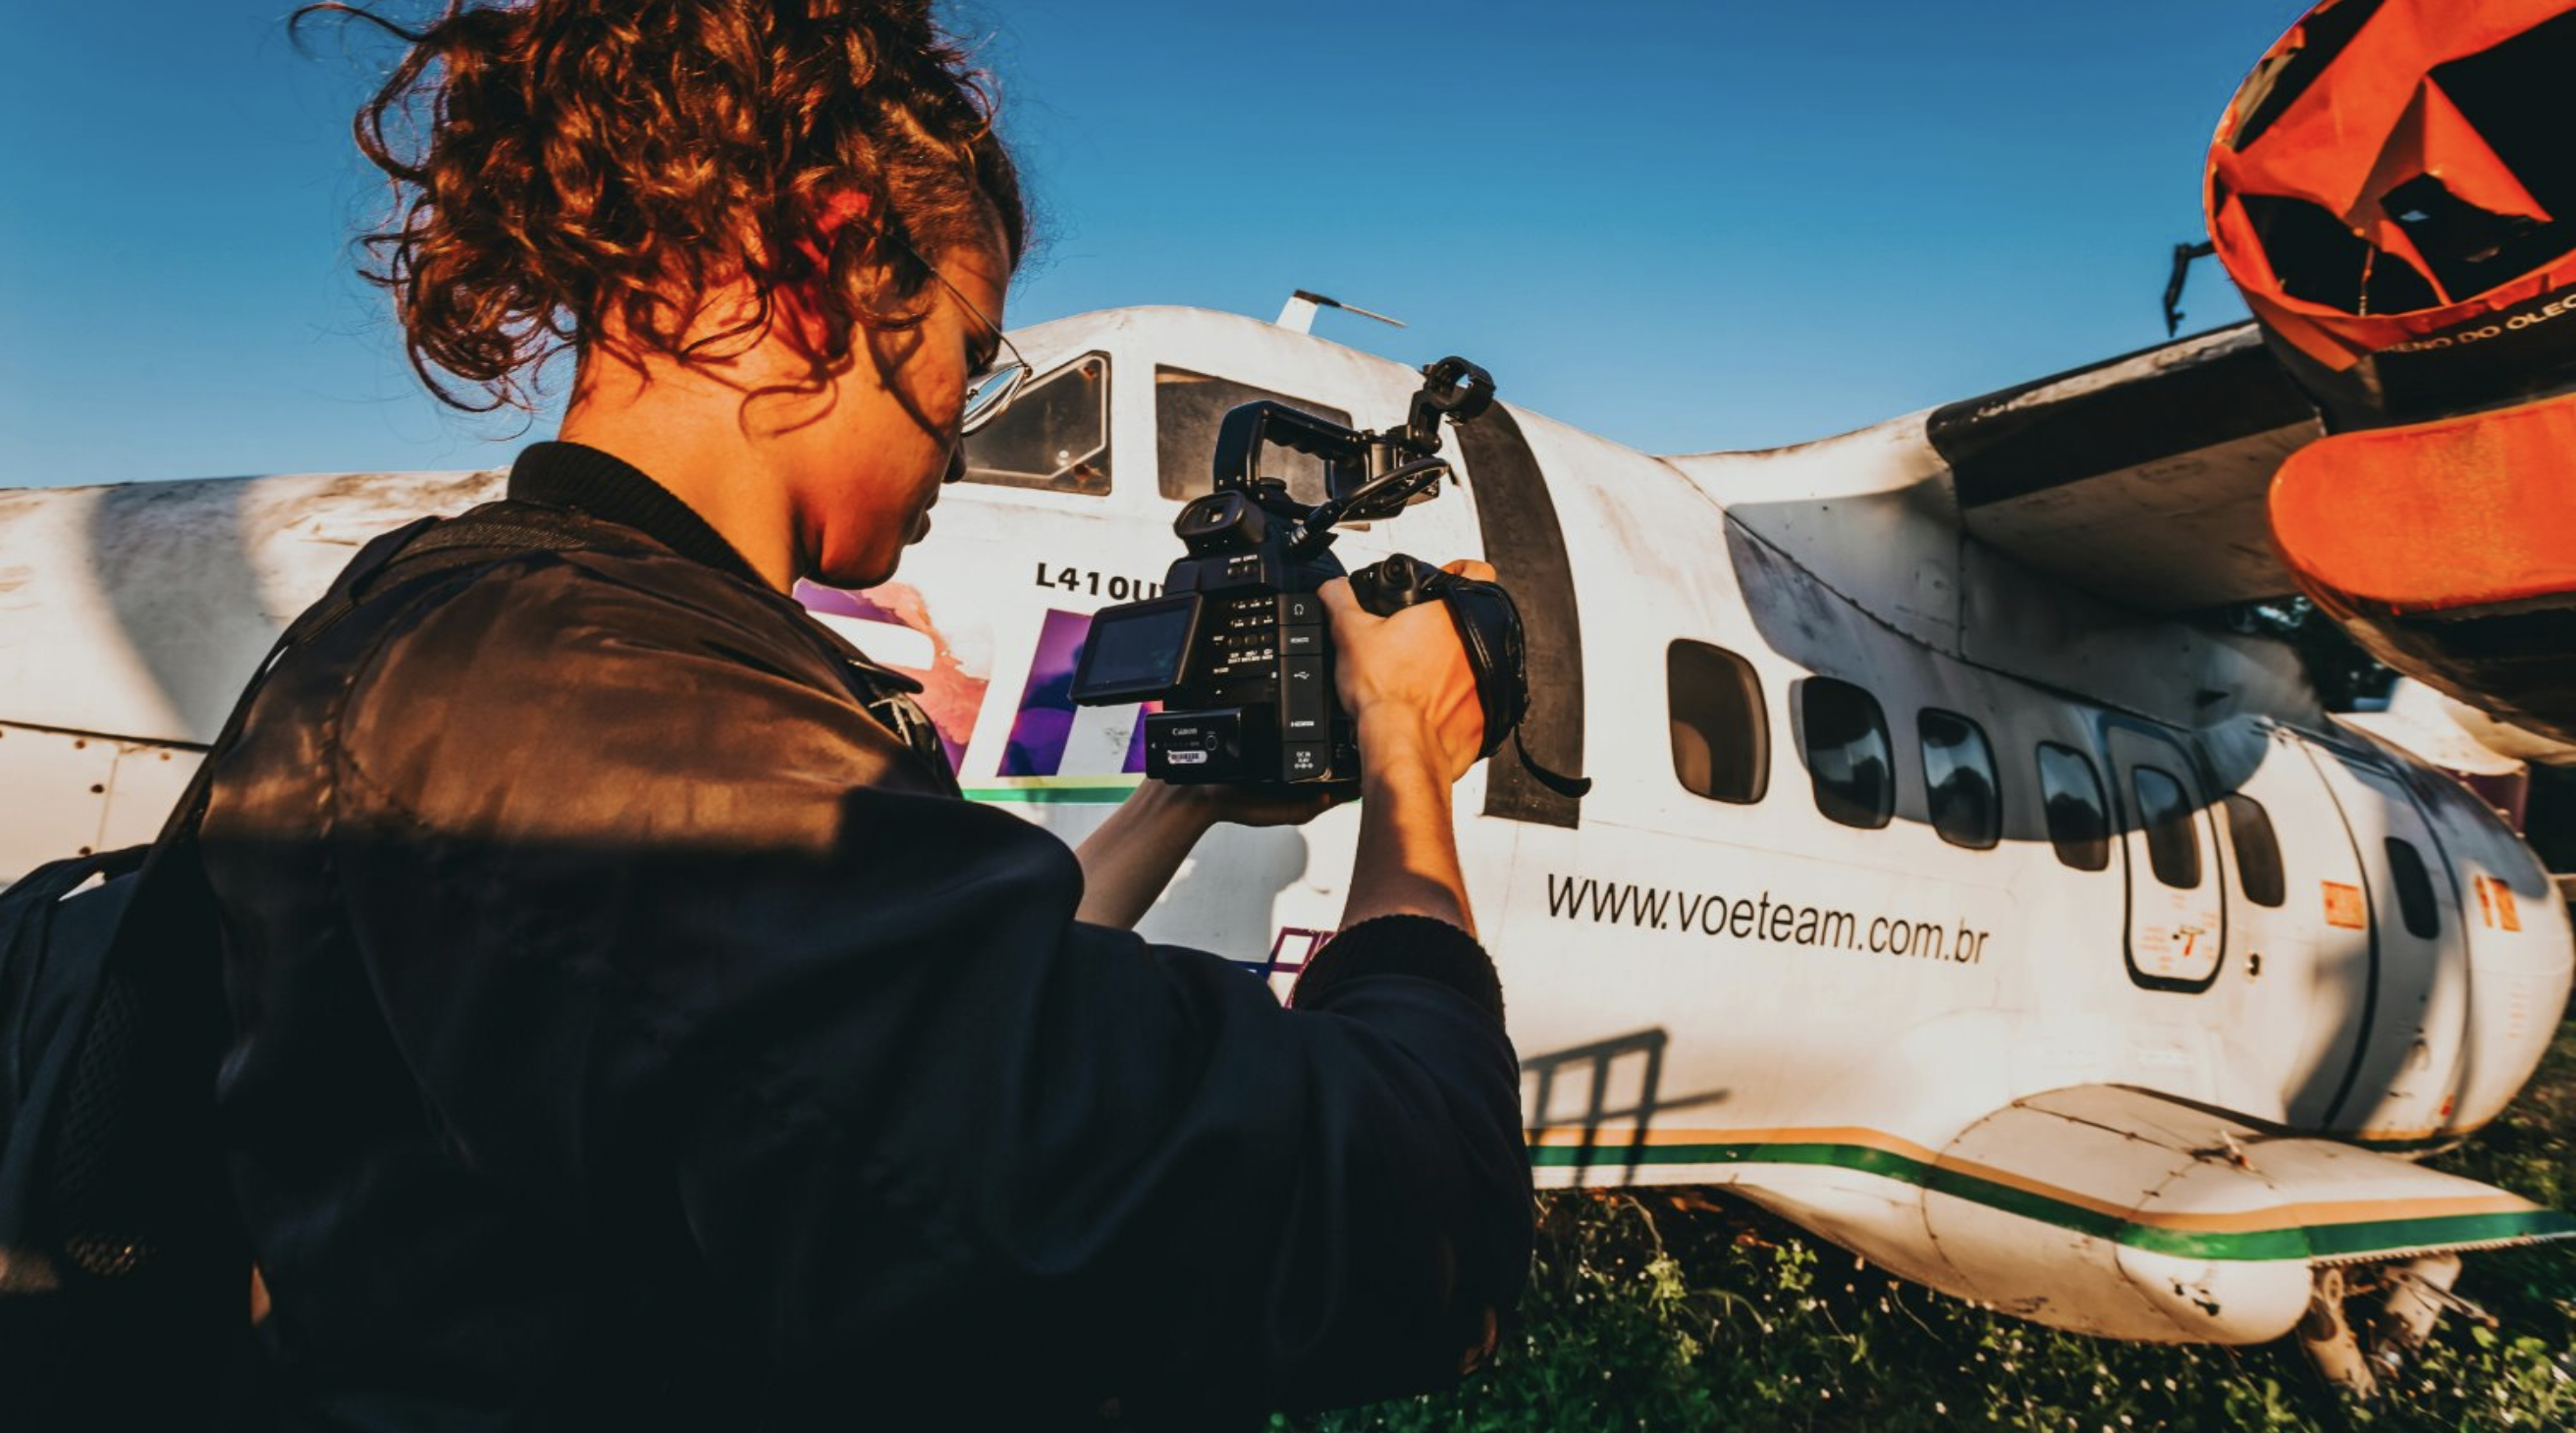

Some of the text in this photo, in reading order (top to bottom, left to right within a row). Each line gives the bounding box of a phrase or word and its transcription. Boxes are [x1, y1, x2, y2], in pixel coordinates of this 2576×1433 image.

[2457, 325, 2501, 344] DO
[1036, 561, 1165, 601] L410U
[1547, 873, 1989, 965] www.voeteam.com.br
